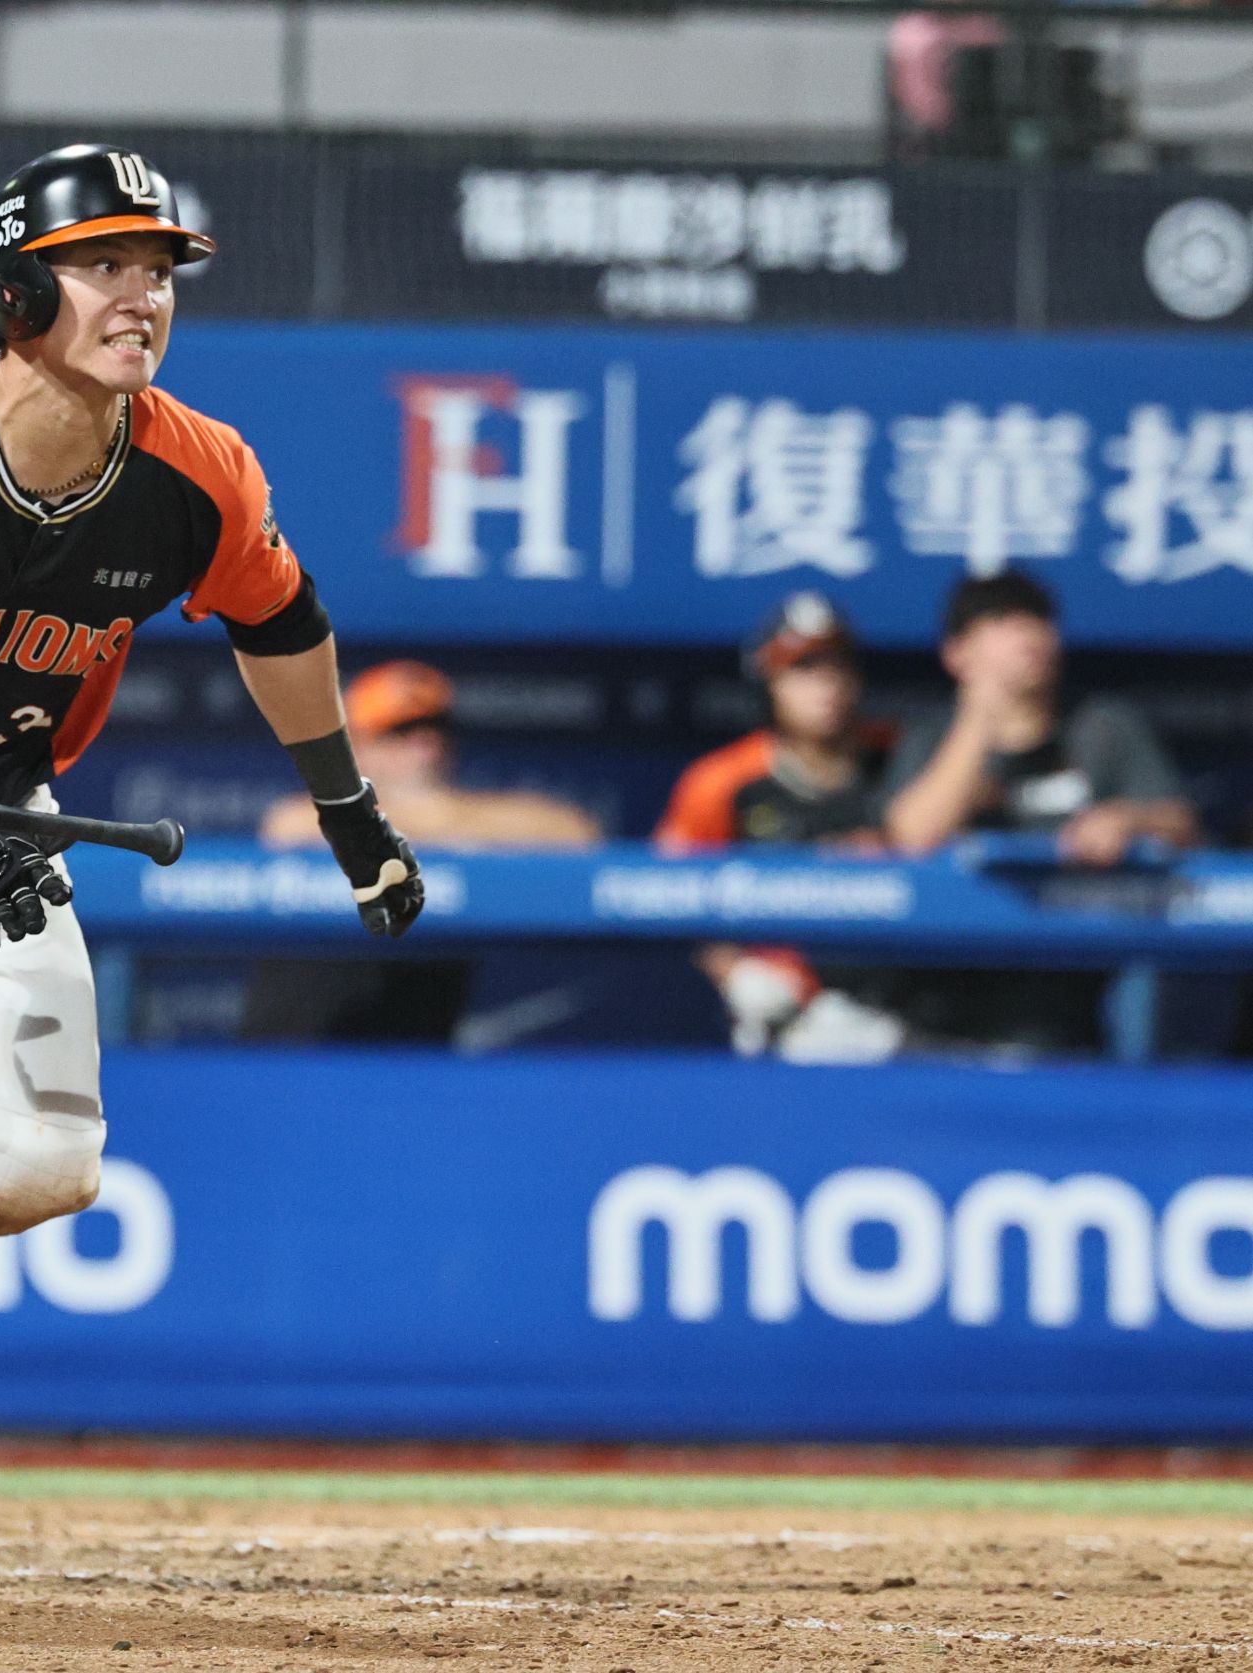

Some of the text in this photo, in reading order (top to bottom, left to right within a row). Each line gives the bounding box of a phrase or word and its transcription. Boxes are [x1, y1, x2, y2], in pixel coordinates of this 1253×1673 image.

[676, 394, 1253, 585] 復華投
[586, 1163, 1253, 1332] momo
